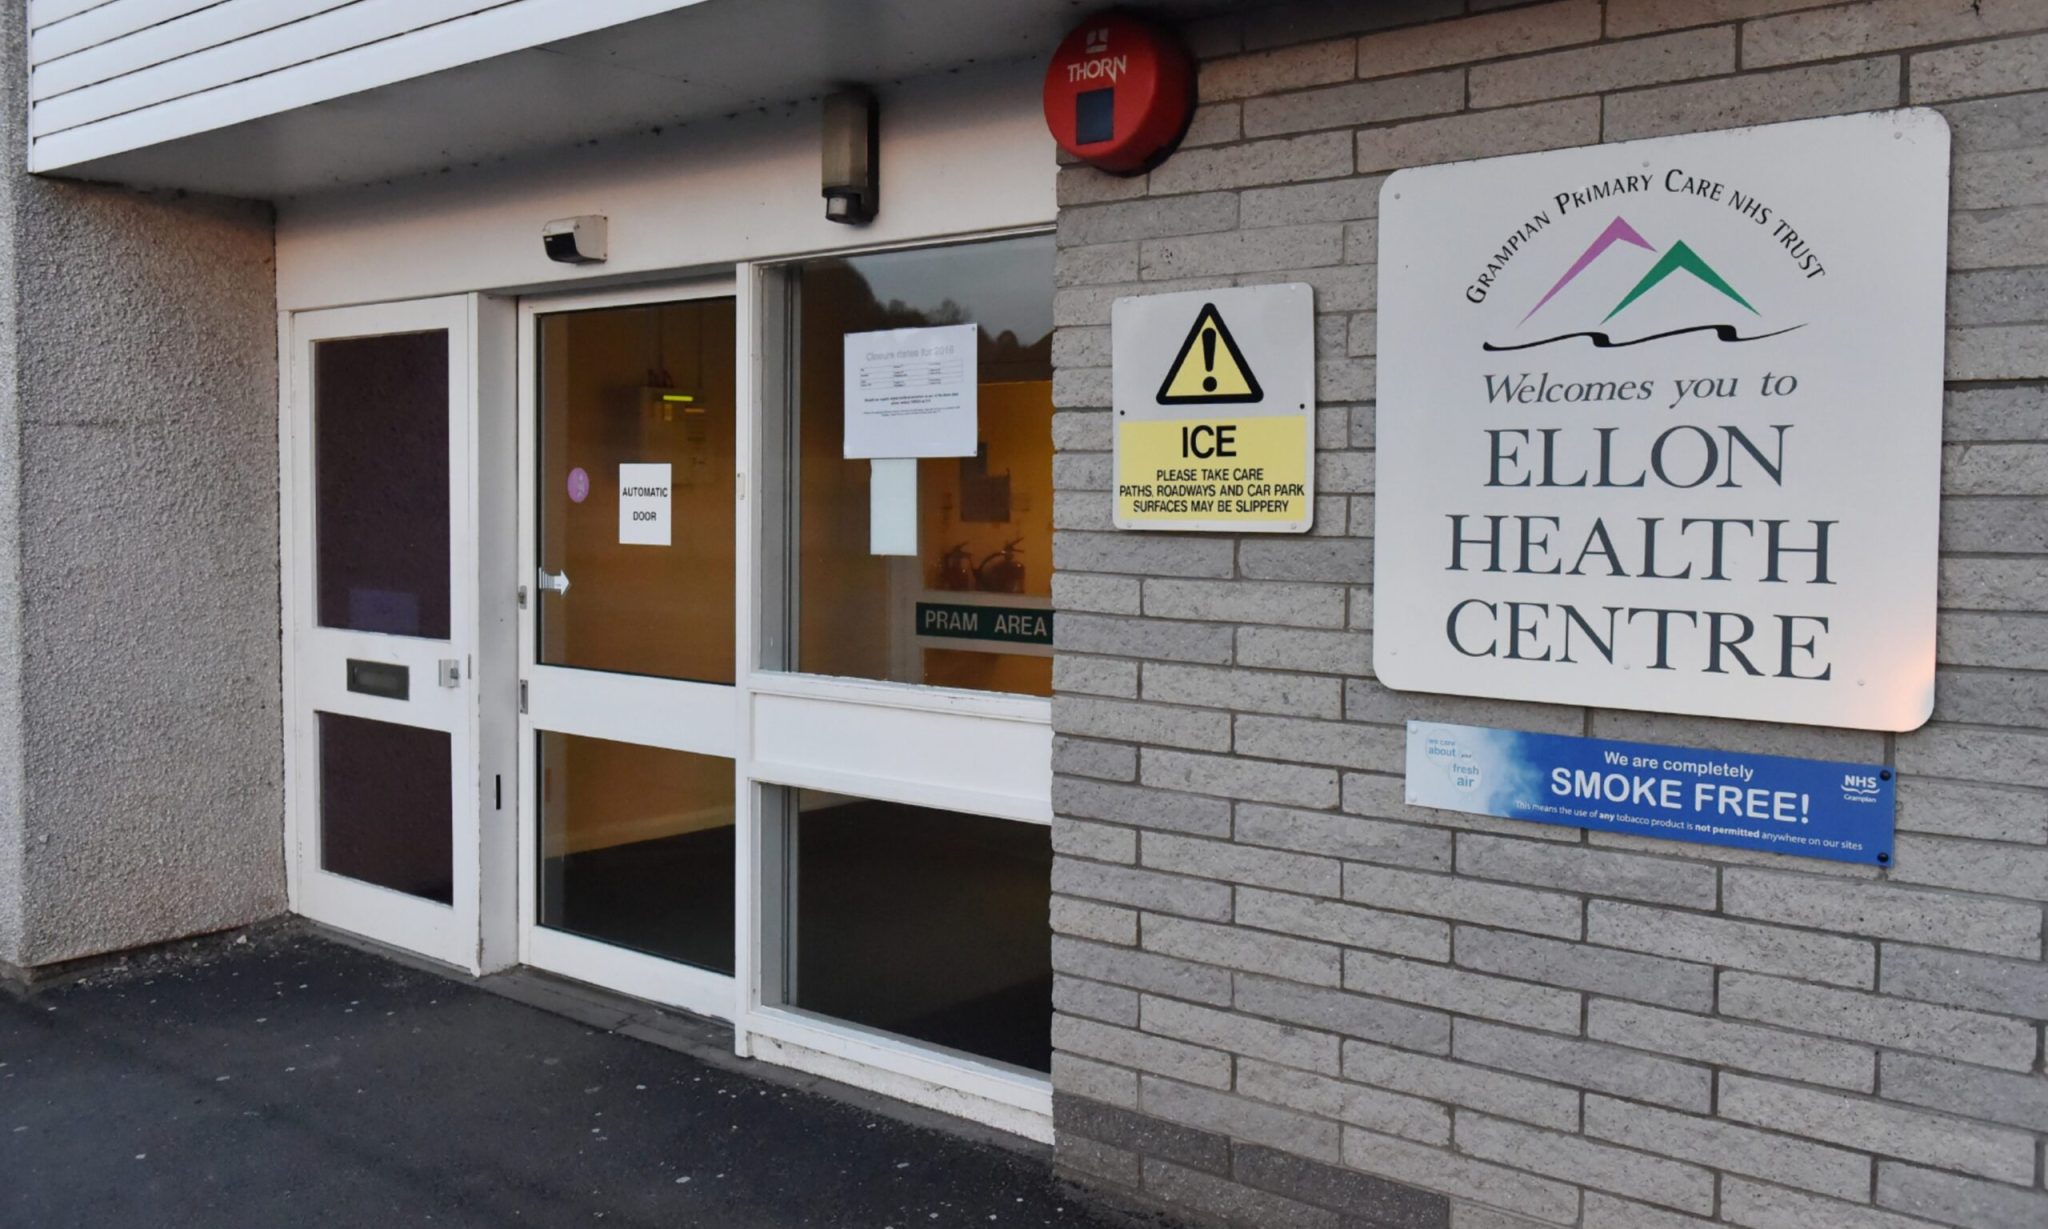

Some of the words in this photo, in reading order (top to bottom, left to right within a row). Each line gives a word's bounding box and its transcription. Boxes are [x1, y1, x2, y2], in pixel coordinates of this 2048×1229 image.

[1067, 55, 1127, 83] THORN
[1728, 190, 1772, 225] NHS
[1773, 219, 1826, 279] TRUST
[1482, 373, 1653, 404] Welcomes
[1668, 377, 1738, 409] you
[1761, 372, 1798, 397] to
[1182, 425, 1237, 459] ICE
[1483, 424, 1794, 488] ELLON
[1156, 469, 1197, 481] PLEASE
[1201, 468, 1229, 481] TAKE
[1233, 468, 1264, 481] CARE
[622, 487, 668, 497] AUTOMATIC
[1157, 484, 1216, 497] ROADWAYS
[1220, 484, 1243, 496] AND
[1247, 484, 1271, 496] CAR
[1274, 484, 1305, 496] PARK
[633, 511, 657, 521] DOOR
[1133, 500, 1188, 513] SURFACES
[1191, 500, 1214, 512] MAY
[1217, 500, 1232, 512] BE
[1236, 499, 1289, 512] SLIPPERY
[1445, 514, 1839, 585] HEALTH
[925, 610, 978, 631] PRAM
[994, 614, 1047, 636] AREA
[1446, 598, 1832, 681] CENTRE
[1428, 746, 1456, 757] about
[1453, 763, 1479, 775] fresh
[1604, 751, 1628, 766] We
[1632, 756, 1658, 769] are
[1663, 759, 1754, 782] completely
[1457, 776, 1475, 787] air
[1844, 774, 1877, 789] NHS
[1551, 767, 1682, 810] SMOKE
[1695, 783, 1809, 824] FREE!
[1515, 800, 1532, 810] This
[1533, 803, 1558, 813] means
[1559, 805, 1572, 815] the
[1574, 808, 1587, 817] use
[1589, 809, 1598, 818] of
[1599, 812, 1615, 822] any
[1616, 814, 1650, 825] tobacco
[1651, 818, 1684, 831] product
[1686, 821, 1693, 830] is
[1695, 823, 1711, 833] not
[1712, 825, 1760, 839] permitted
[1761, 831, 1806, 845] anywhere
[1808, 837, 1821, 846] on
[1823, 839, 1839, 848] our
[1841, 841, 1863, 851] sites
